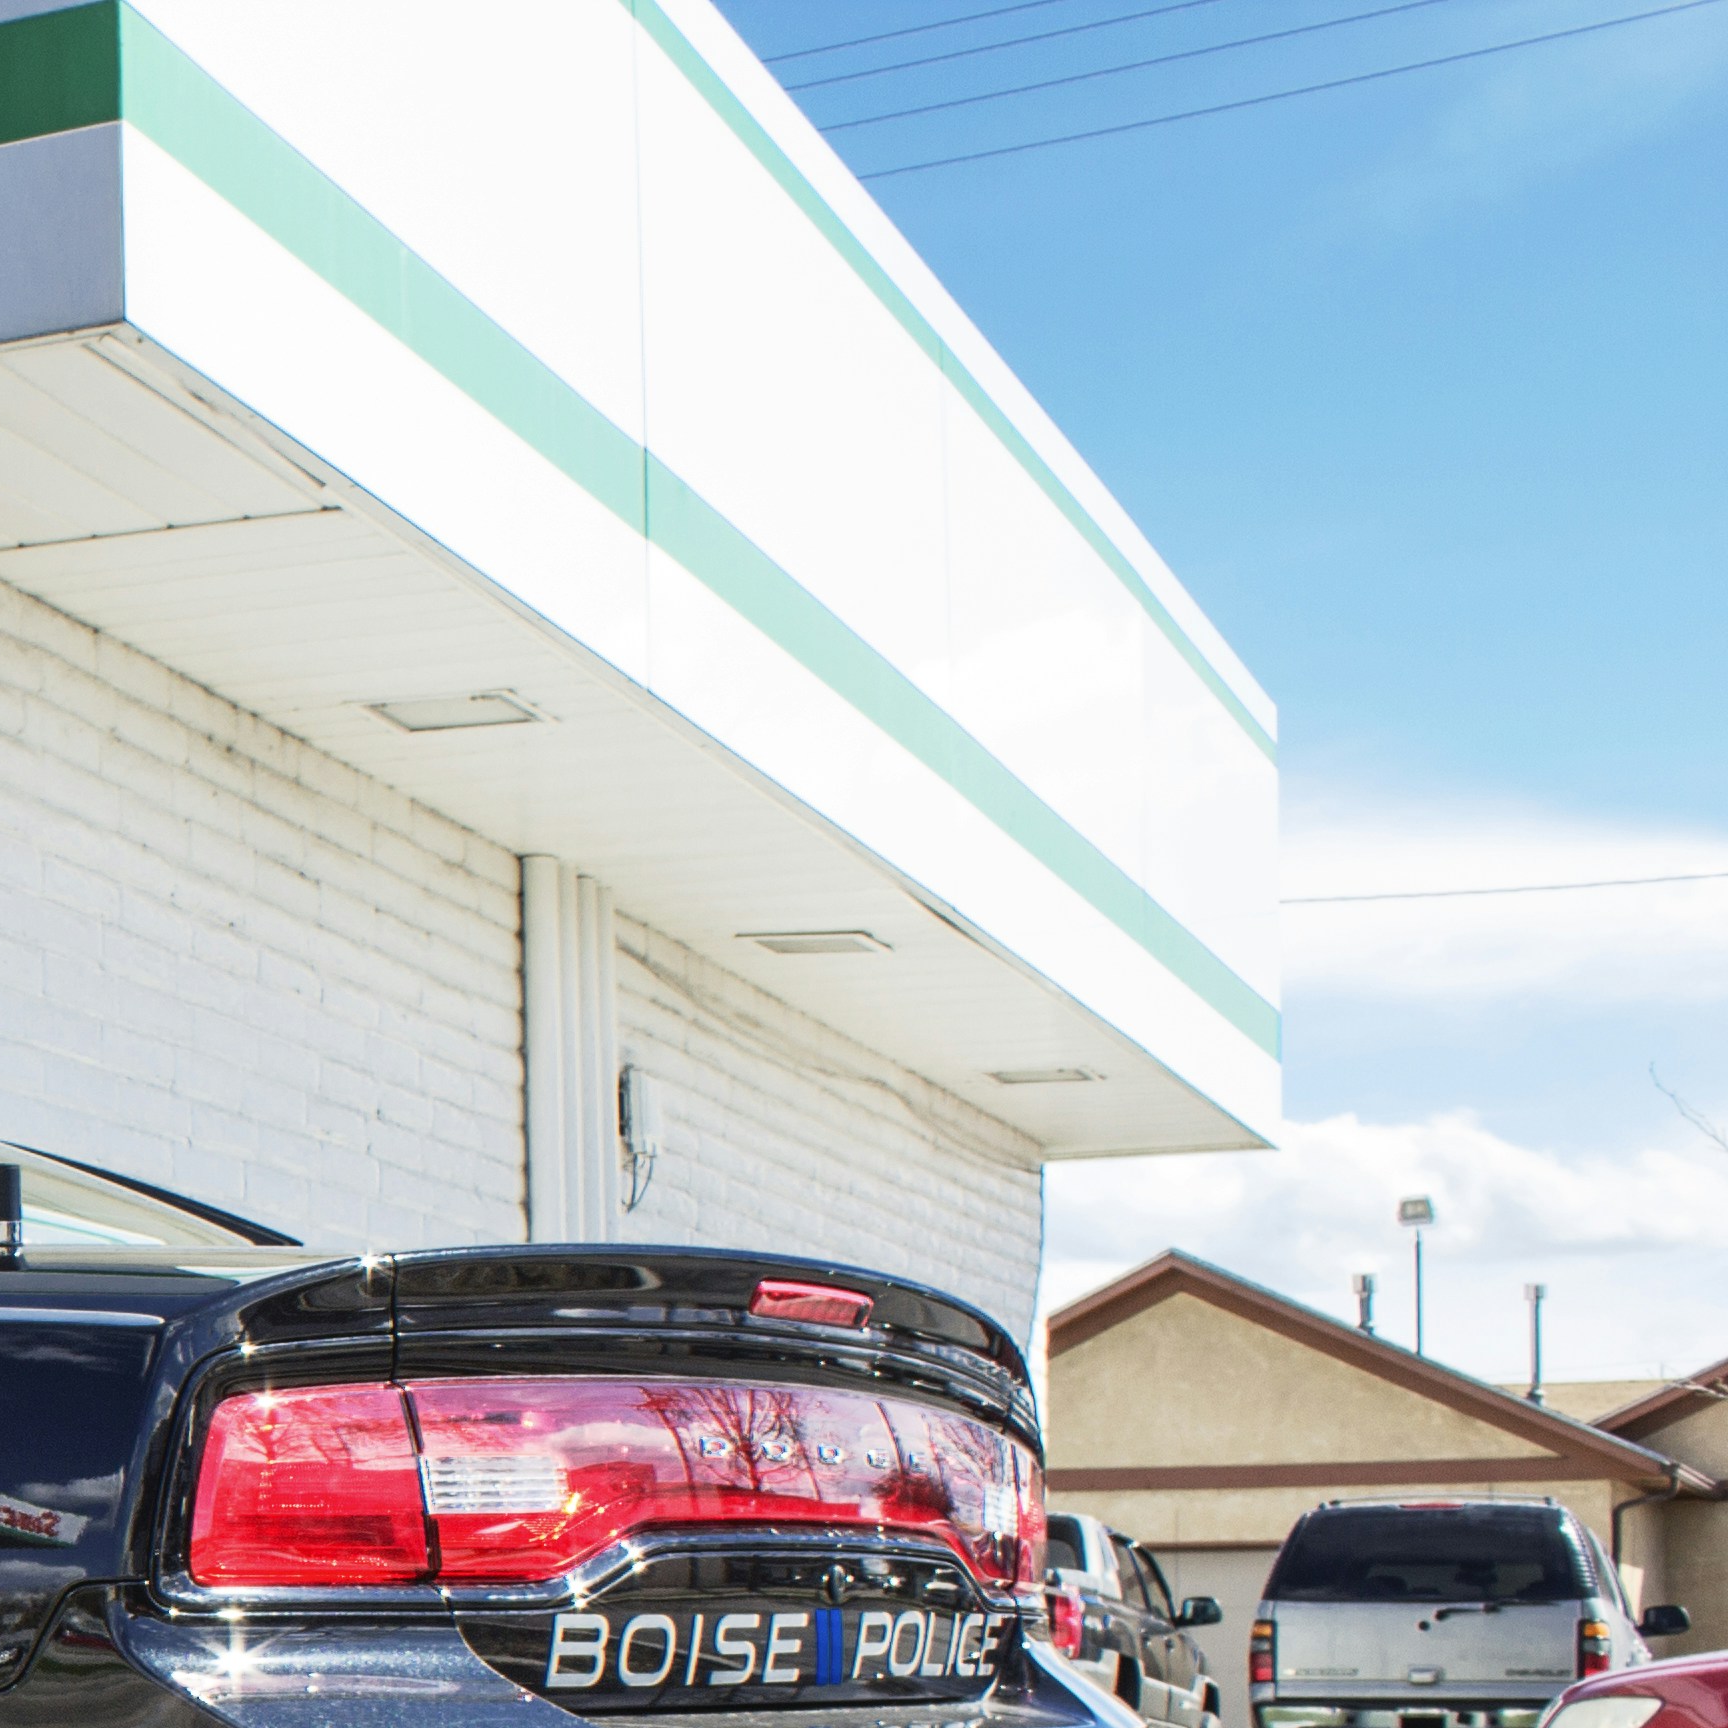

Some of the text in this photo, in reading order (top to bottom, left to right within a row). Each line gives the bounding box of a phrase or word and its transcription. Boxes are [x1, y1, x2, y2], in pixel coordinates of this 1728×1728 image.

[699, 1435, 929, 1474] DODGE
[546, 1610, 1003, 1688] BOISE POLICE
